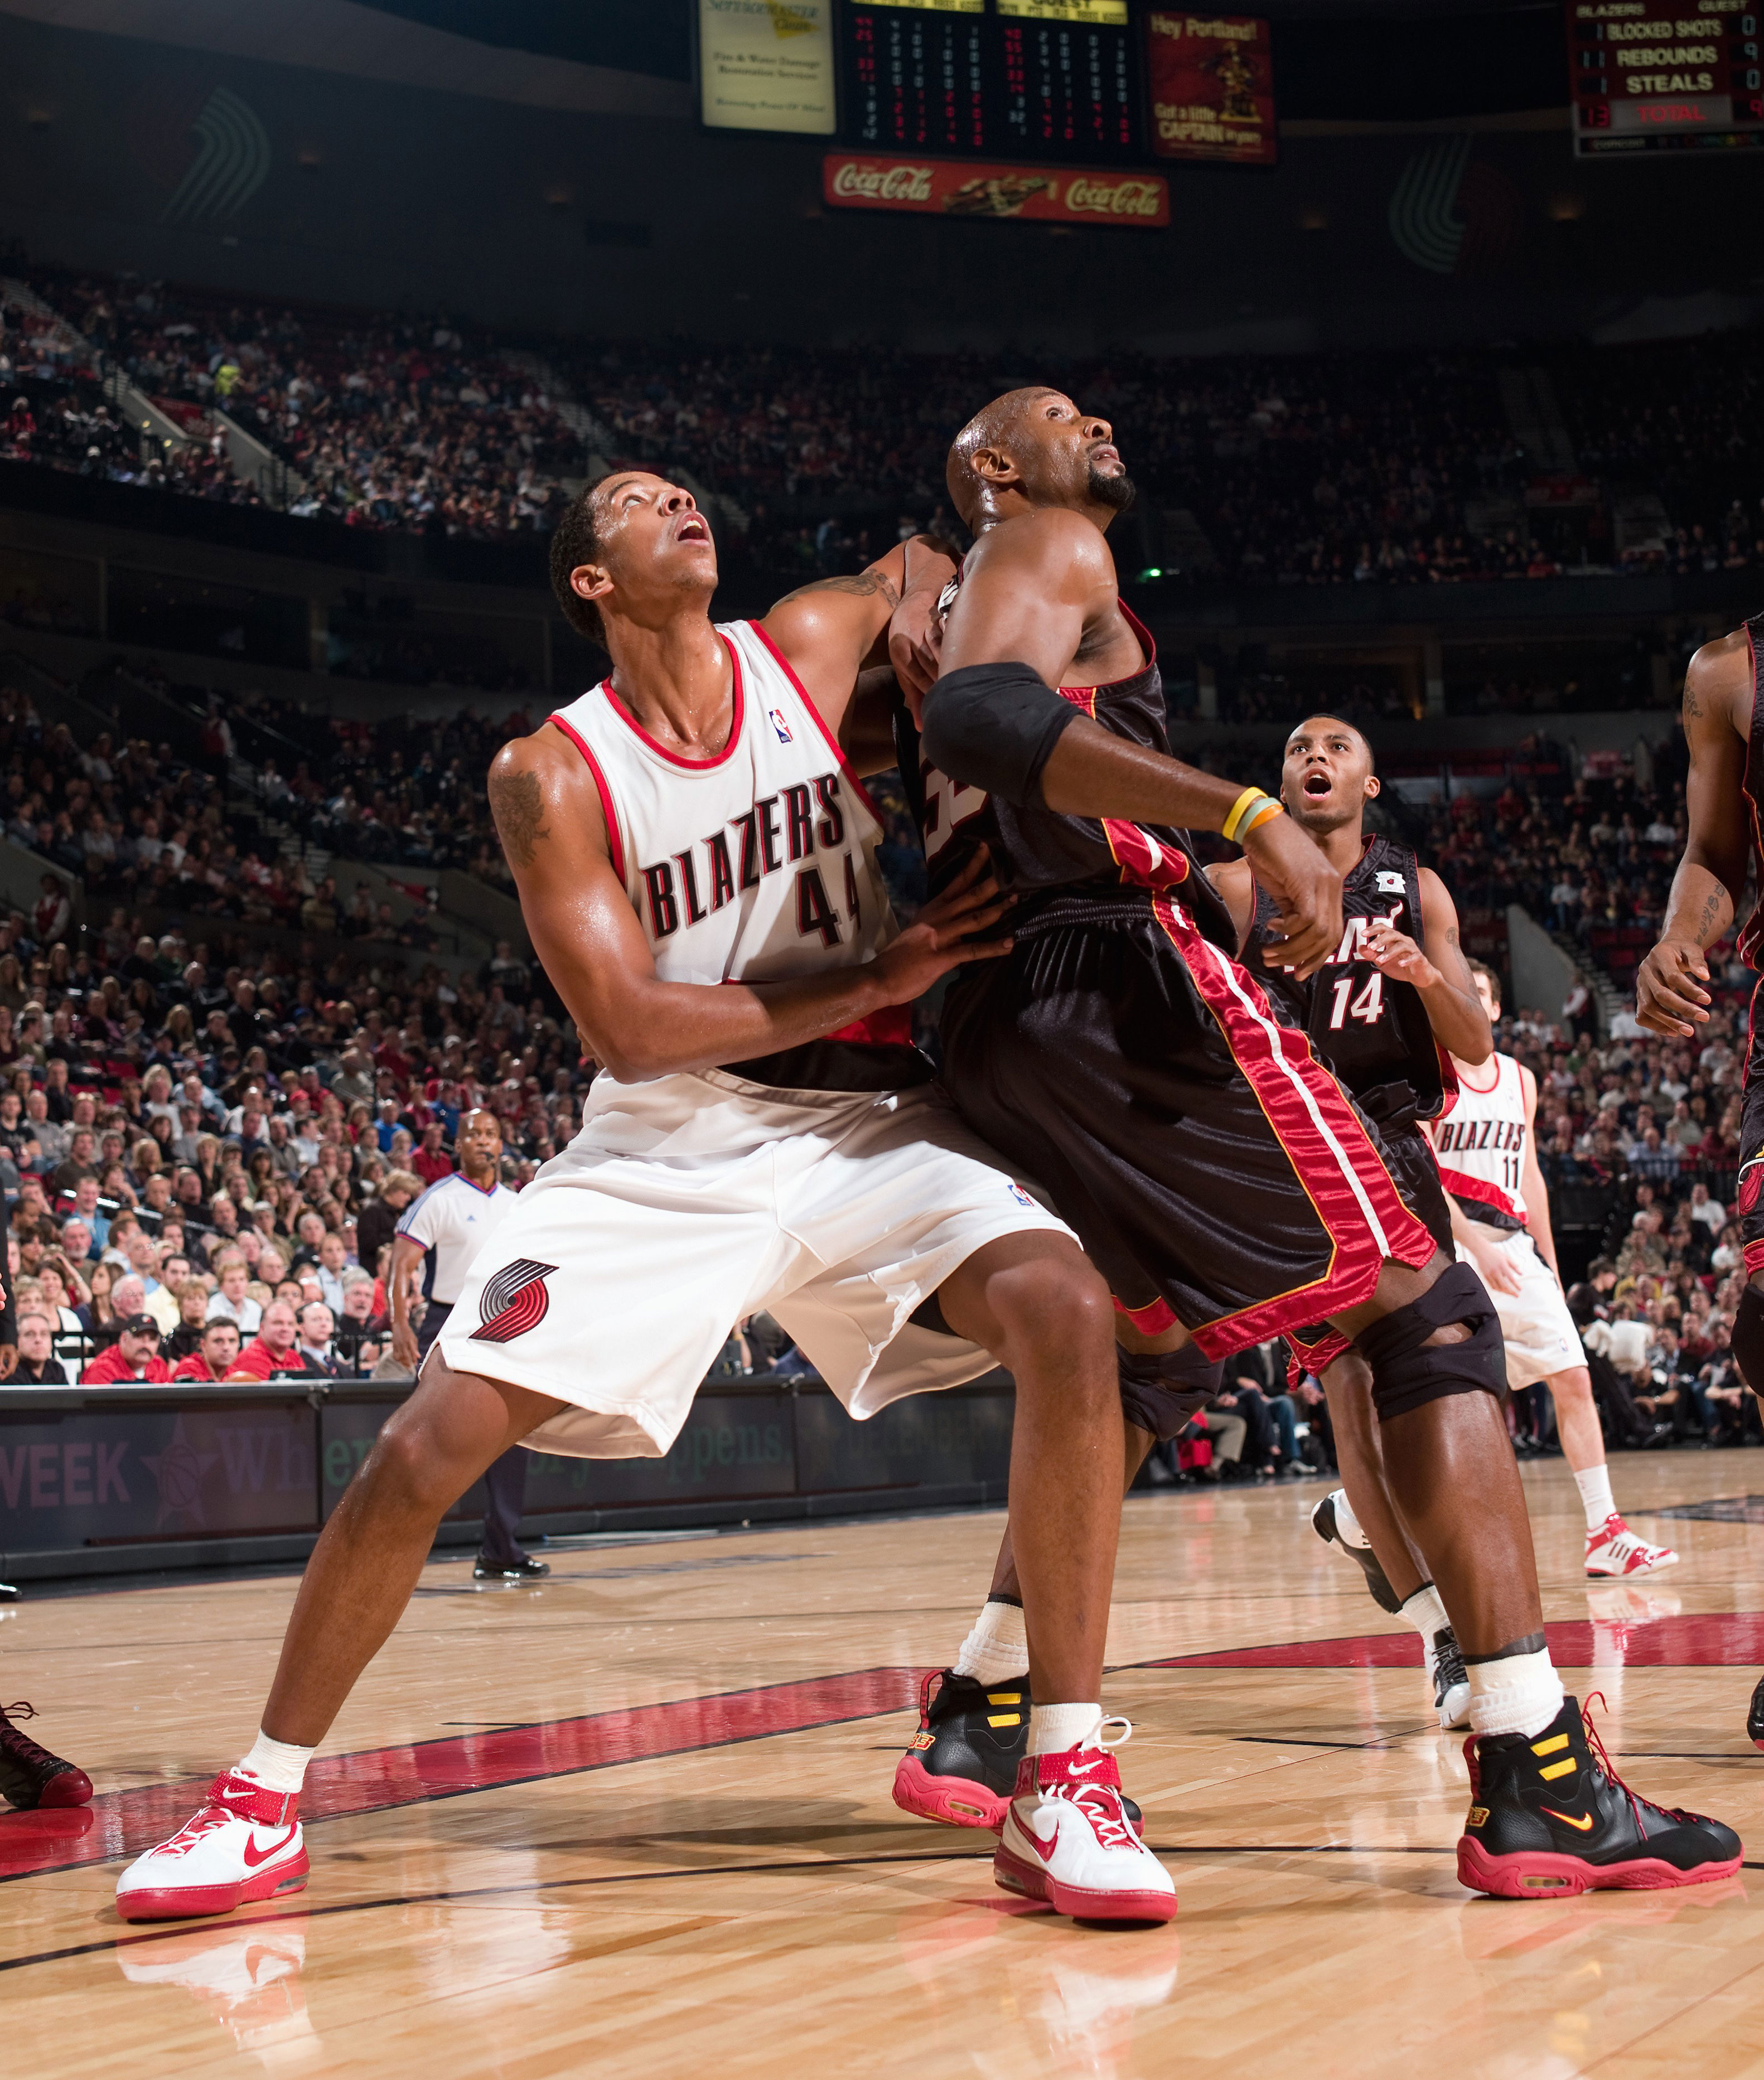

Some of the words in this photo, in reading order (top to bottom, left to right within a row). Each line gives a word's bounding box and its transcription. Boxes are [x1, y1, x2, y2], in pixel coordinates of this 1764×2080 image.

[1576, 2, 1646, 18] BLAZERS
[1151, 14, 1182, 40] Hey
[1606, 21, 1674, 41] BLOCKED
[1675, 18, 1723, 38] SHOTS
[1616, 45, 1719, 67] REBOUNDS
[1626, 72, 1715, 94] STEALS
[1637, 104, 1707, 123] TOTAL
[1158, 120, 1225, 143] CAPTAIN
[639, 771, 845, 941] BLAZERS
[1328, 971, 1384, 1031] 14
[1437, 1120, 1526, 1153] BLAZERS
[1504, 1155, 1519, 1189] 11
